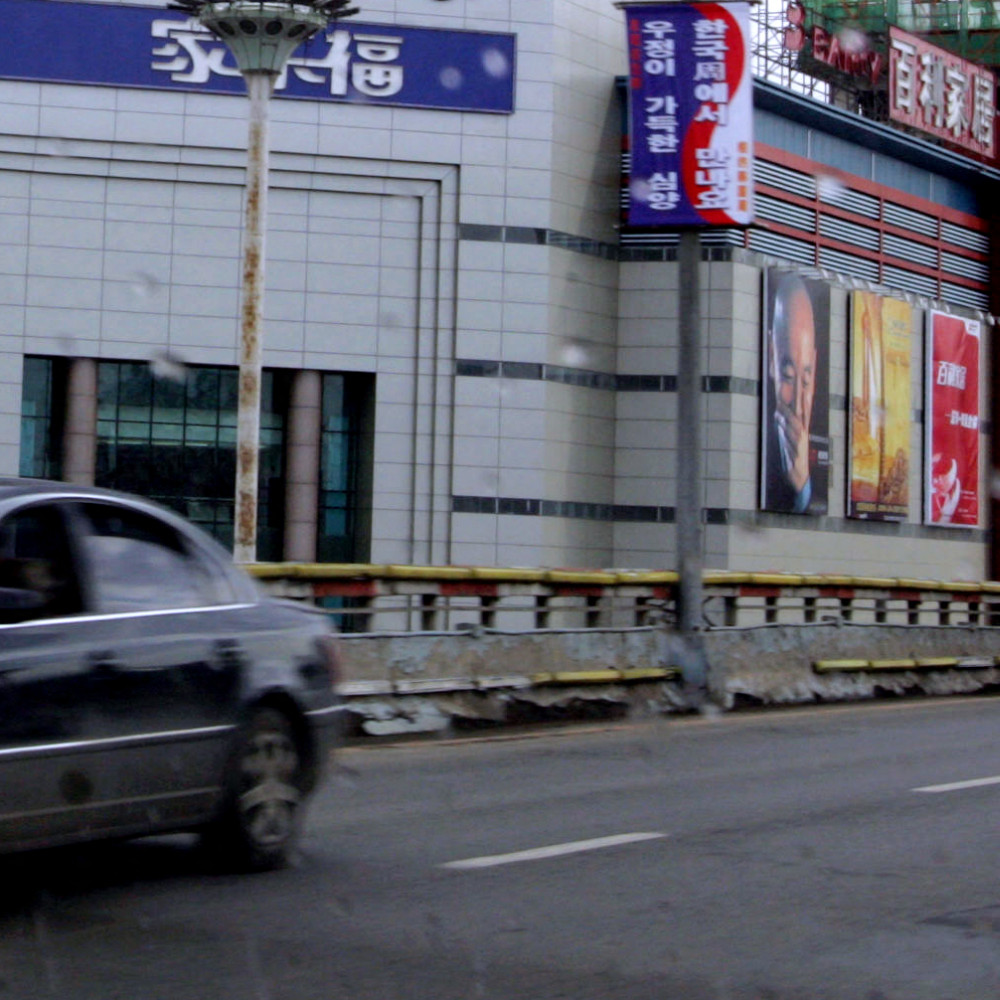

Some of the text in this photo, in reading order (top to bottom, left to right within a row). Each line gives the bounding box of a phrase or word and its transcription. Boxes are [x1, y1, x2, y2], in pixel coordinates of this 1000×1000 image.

[642, 20, 681, 212] 우정이 가득한 심양
